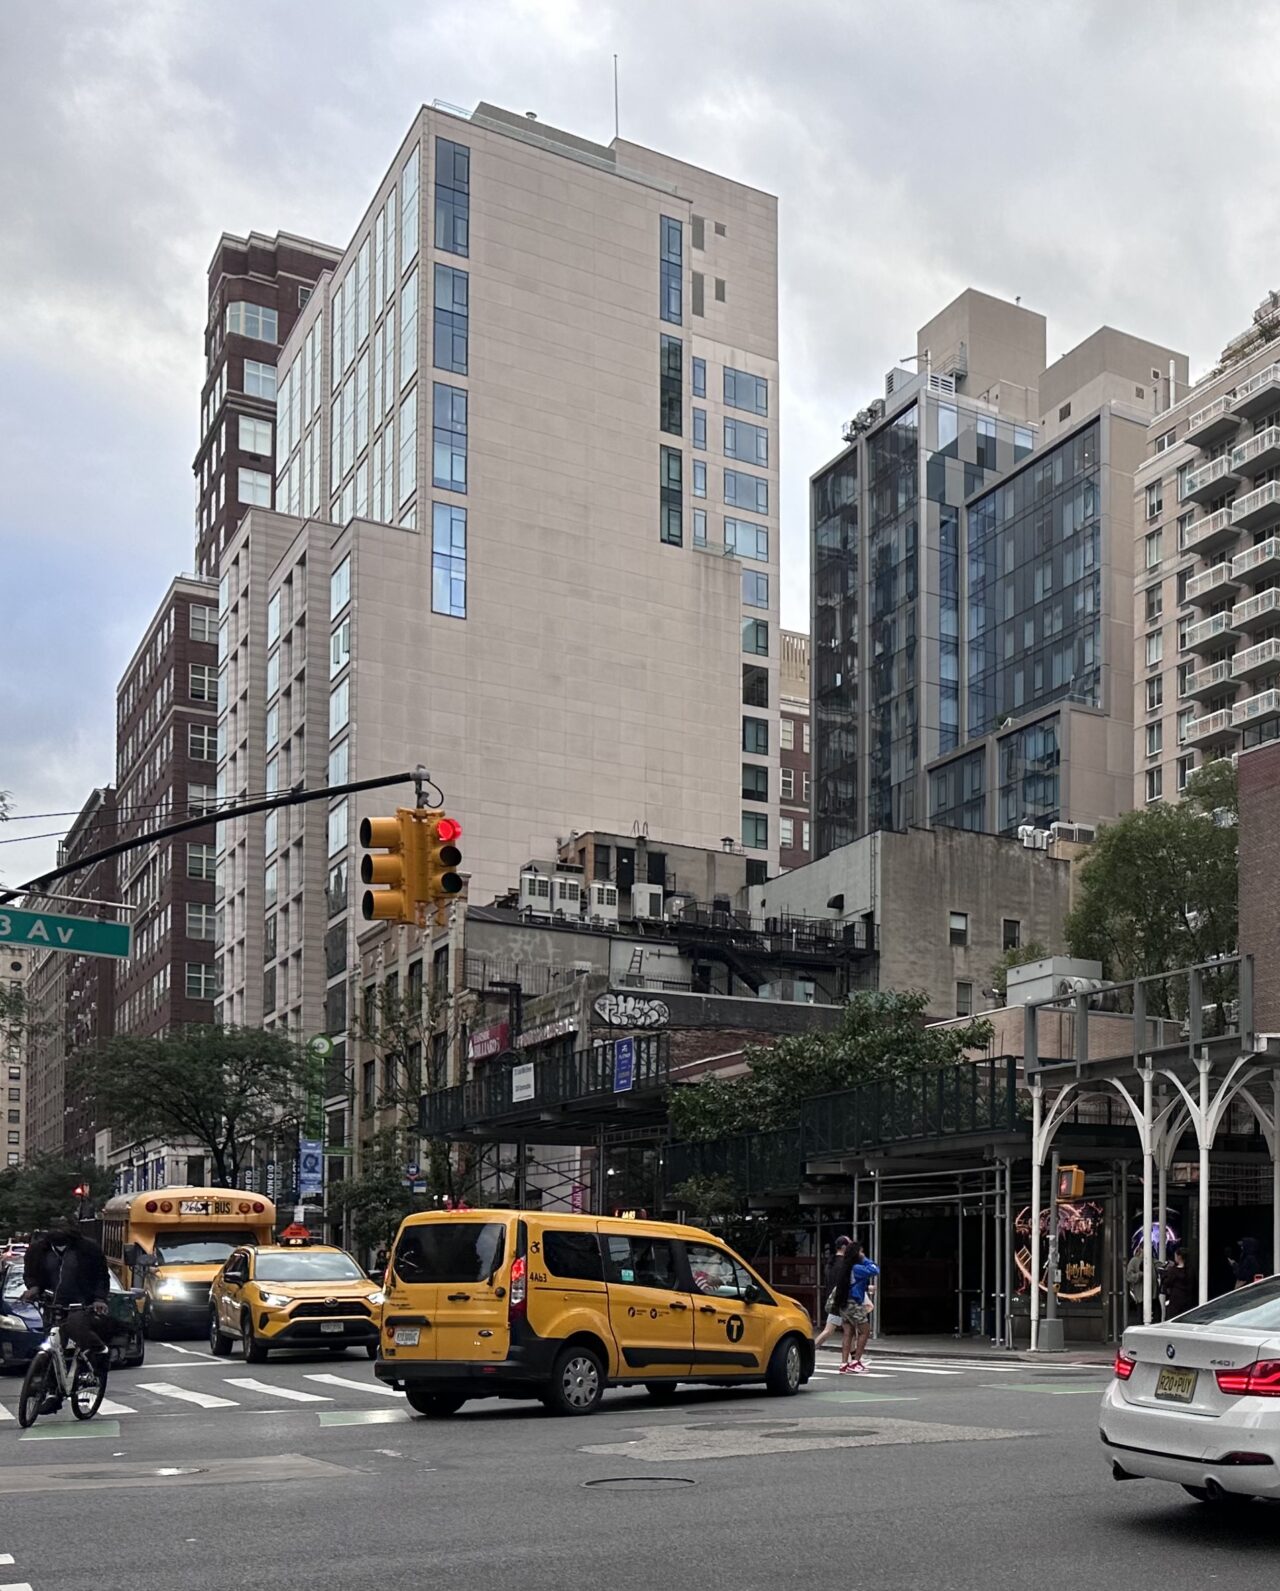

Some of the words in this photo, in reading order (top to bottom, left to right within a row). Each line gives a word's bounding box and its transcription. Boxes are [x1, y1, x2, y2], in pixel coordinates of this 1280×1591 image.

[0, 914, 12, 936] 3
[27, 919, 74, 943] Av
[267, 1164, 275, 1179] OLD
[215, 1202, 231, 1214] BUS
[1210, 1359, 1235, 1367] 440i
